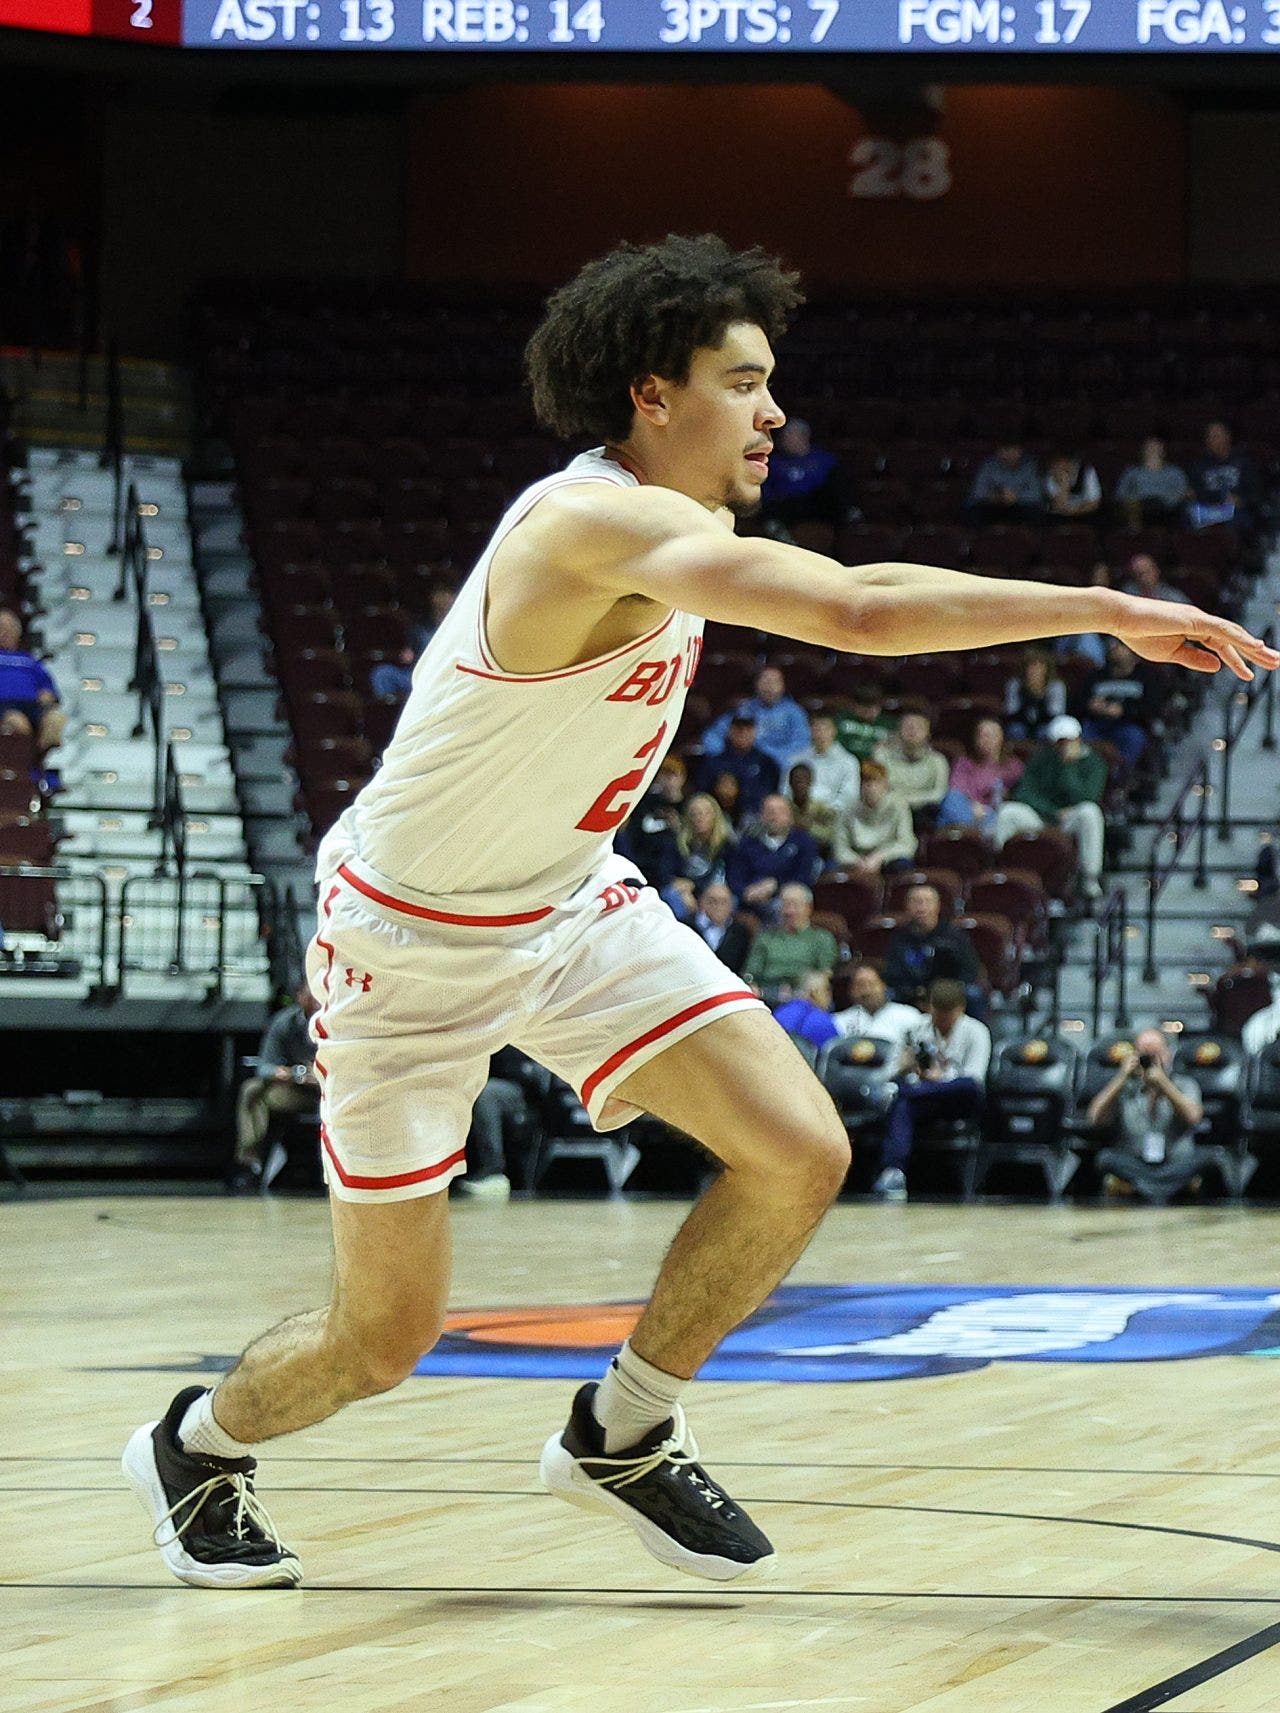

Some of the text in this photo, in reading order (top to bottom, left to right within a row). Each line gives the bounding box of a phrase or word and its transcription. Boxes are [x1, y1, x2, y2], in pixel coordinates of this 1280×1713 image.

[130, 0, 154, 29] 2
[211, 0, 319, 41] AST:
[342, 0, 394, 42] 13
[422, 0, 529, 43] REB:
[550, 0, 605, 43] 14
[659, 0, 792, 43] 3PTS:
[809, 0, 838, 43] 7
[898, 0, 1015, 44] FGM:
[1034, 0, 1091, 44] 17
[1137, 0, 1246, 44] FGA:
[850, 137, 952, 199] 28
[575, 720, 668, 833] 2
